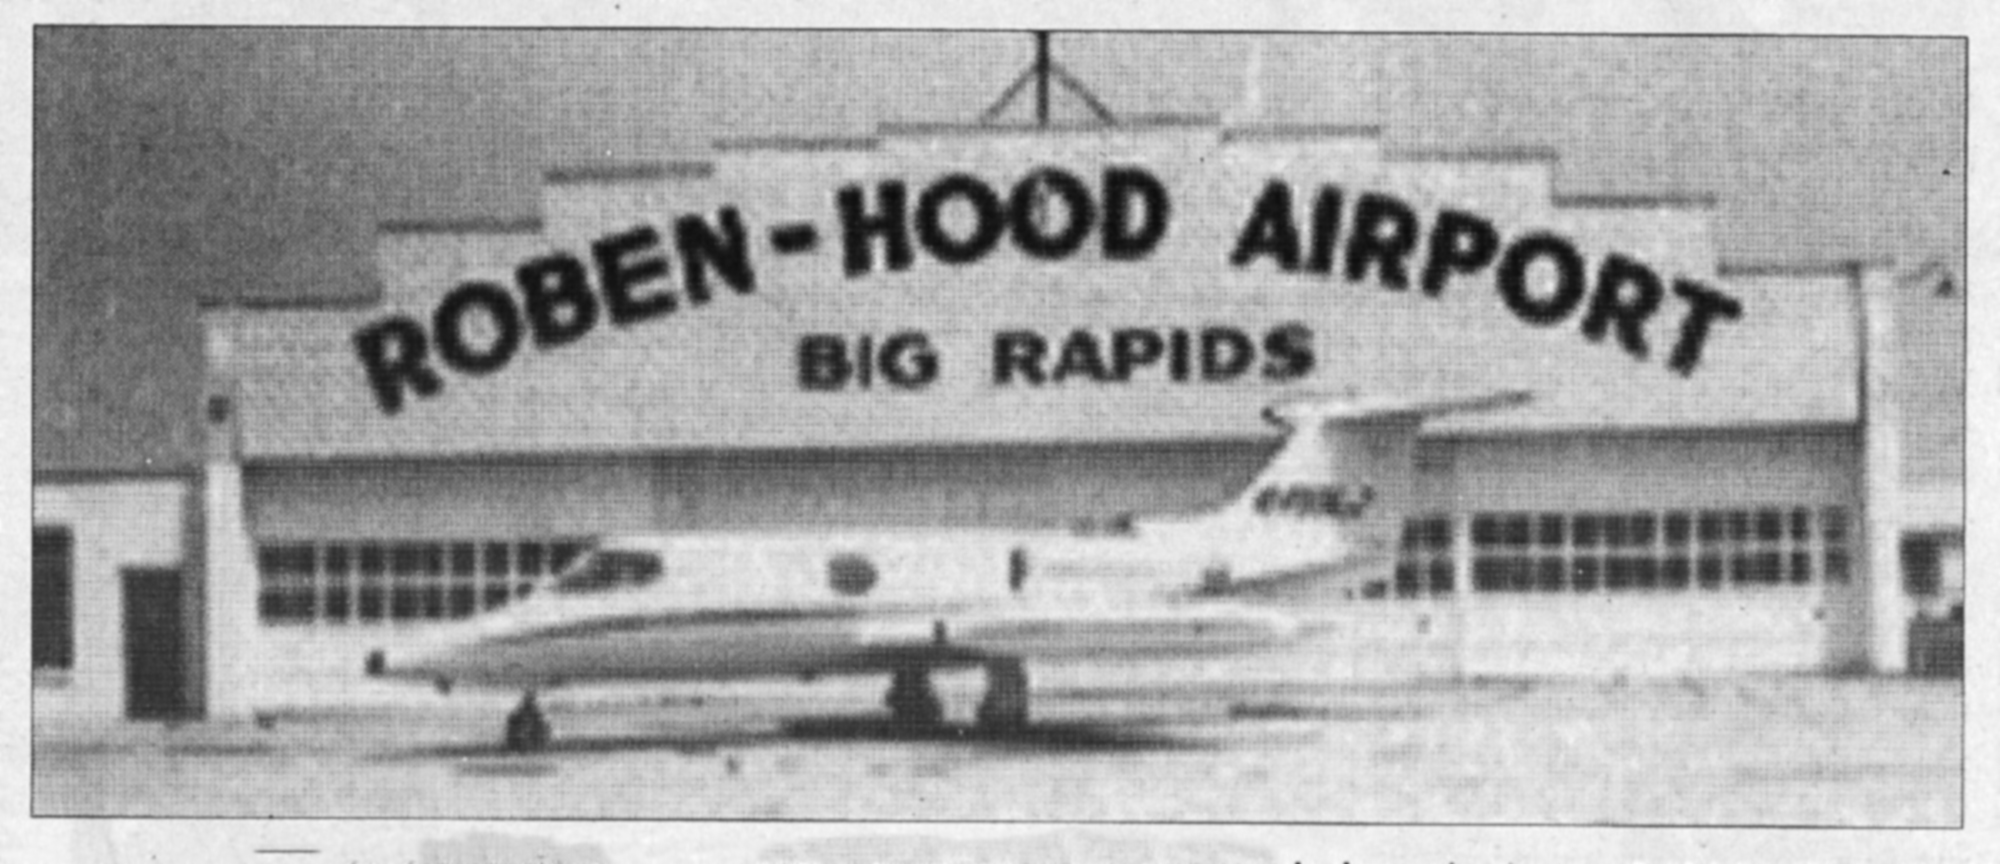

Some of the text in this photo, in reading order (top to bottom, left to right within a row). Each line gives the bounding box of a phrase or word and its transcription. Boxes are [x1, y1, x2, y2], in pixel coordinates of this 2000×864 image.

[1229, 178, 1743, 378] AIRPORT
[797, 322, 1316, 391] BIG RAPIDS
